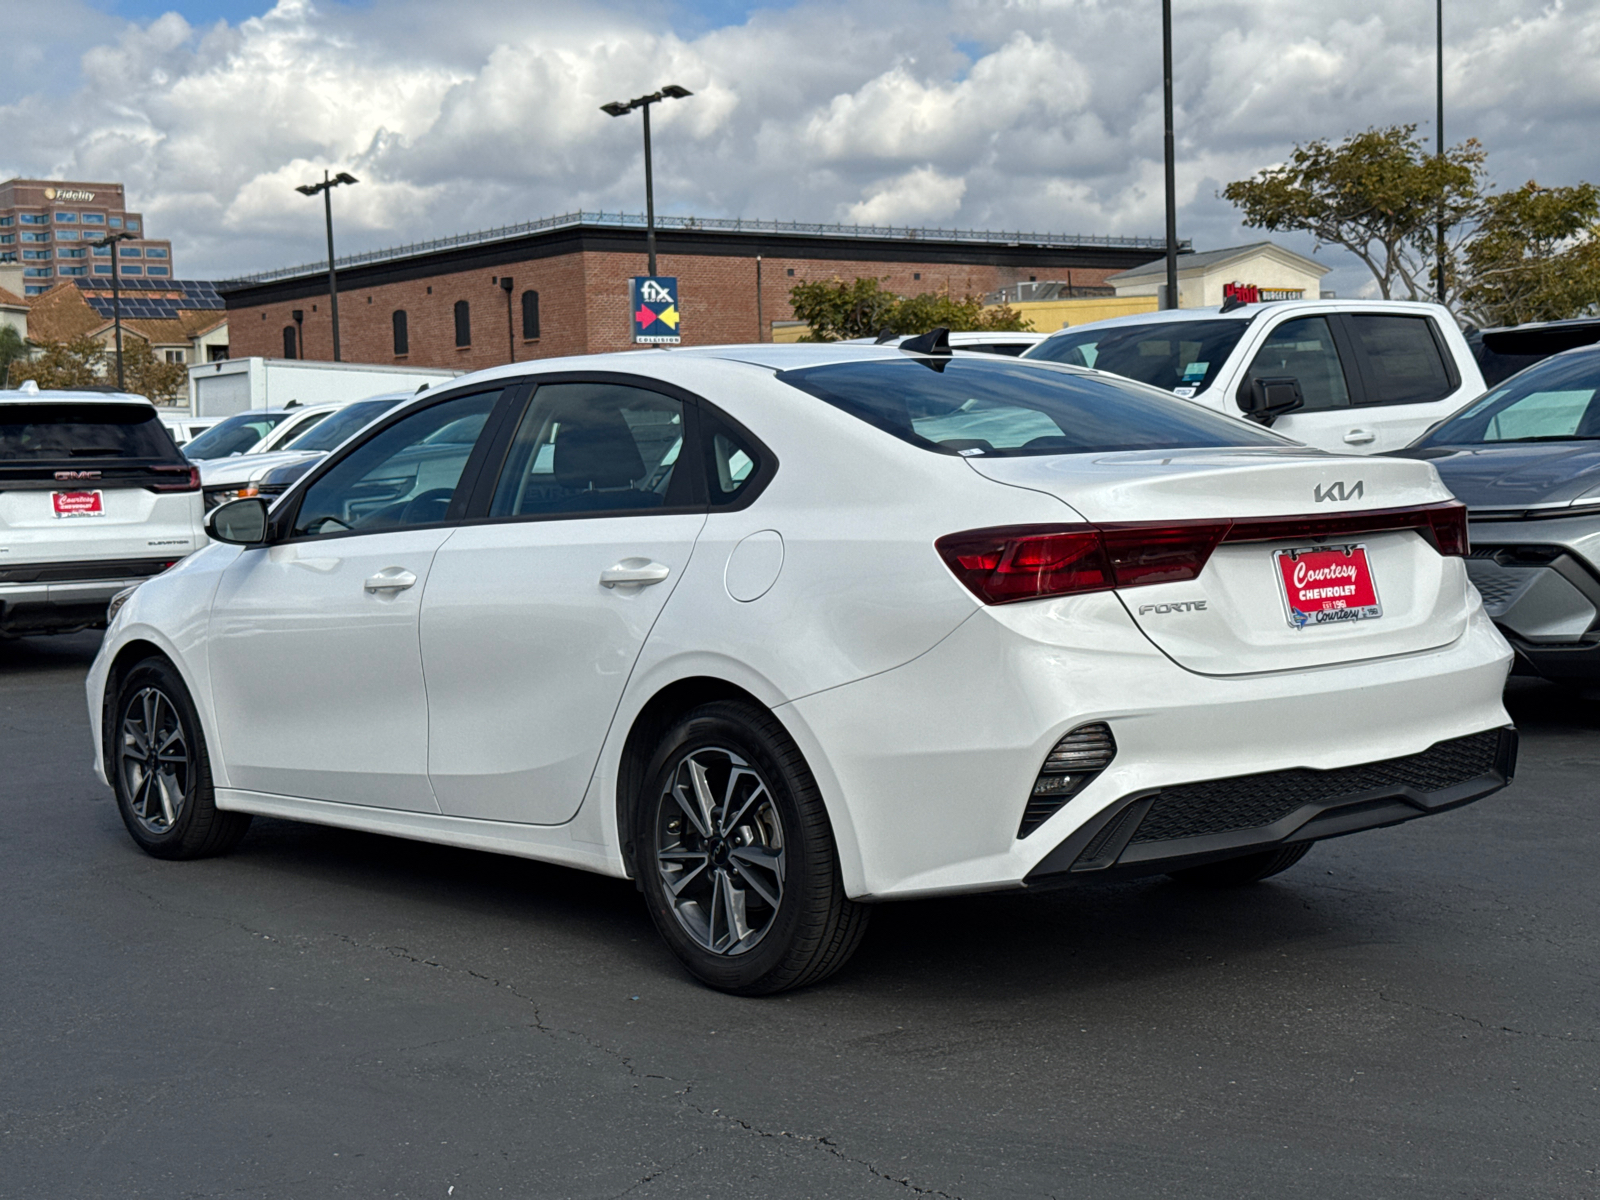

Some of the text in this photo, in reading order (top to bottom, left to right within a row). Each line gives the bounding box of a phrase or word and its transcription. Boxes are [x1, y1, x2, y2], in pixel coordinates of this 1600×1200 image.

[56, 190, 95, 202] Fidelity
[640, 280, 674, 303] fix
[54, 471, 102, 480] GMC
[1294, 561, 1357, 589] Courtesy
[1299, 585, 1356, 601] CHEVROLET
[1139, 600, 1208, 616] FORTE
[1315, 606, 1359, 623] Courtesy
